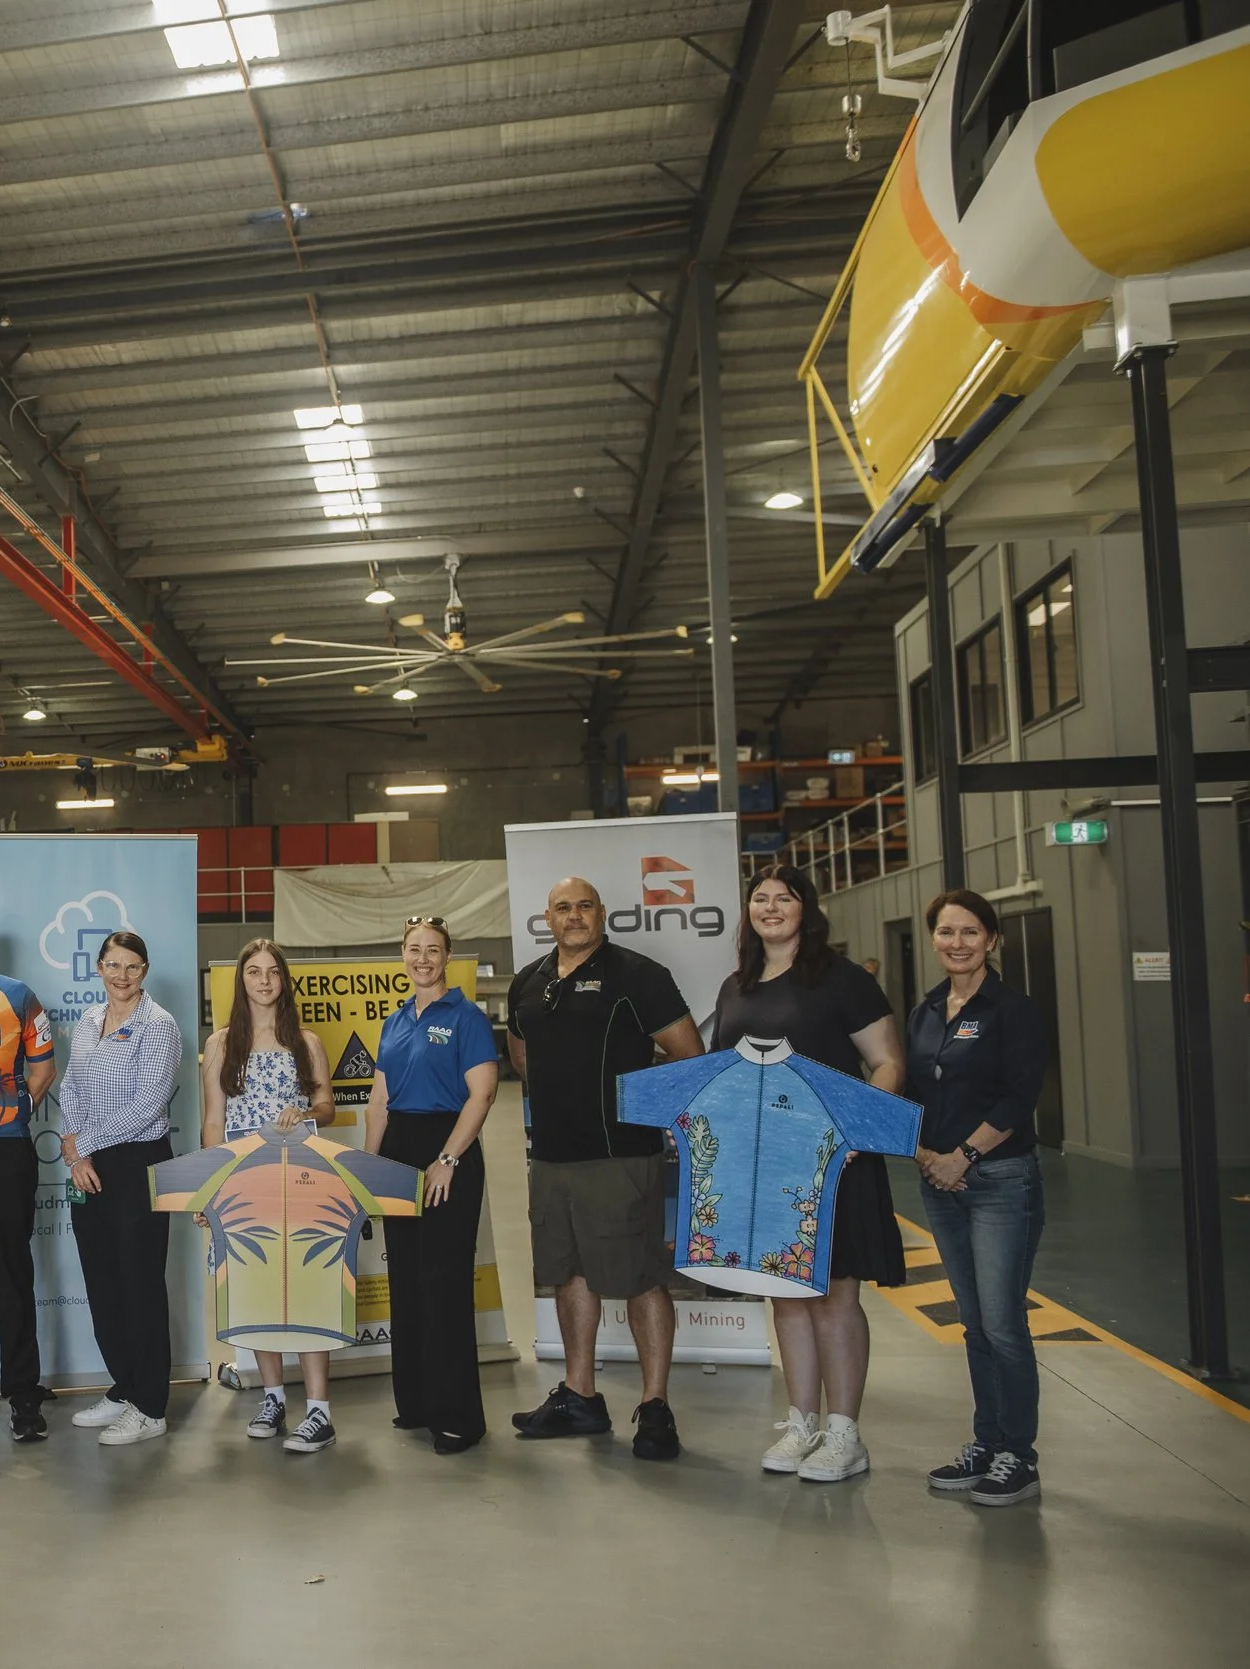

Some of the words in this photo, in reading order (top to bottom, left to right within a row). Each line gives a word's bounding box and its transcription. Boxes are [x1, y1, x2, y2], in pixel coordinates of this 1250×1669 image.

[527, 904, 725, 945] gding
[62, 991, 108, 1004] CLOU
[44, 1008, 86, 1022] CHN
[295, 1001, 342, 1023] EEN
[333, 1092, 357, 1101] When
[689, 1311, 746, 1330] Mining
[356, 1327, 391, 1342] AA
